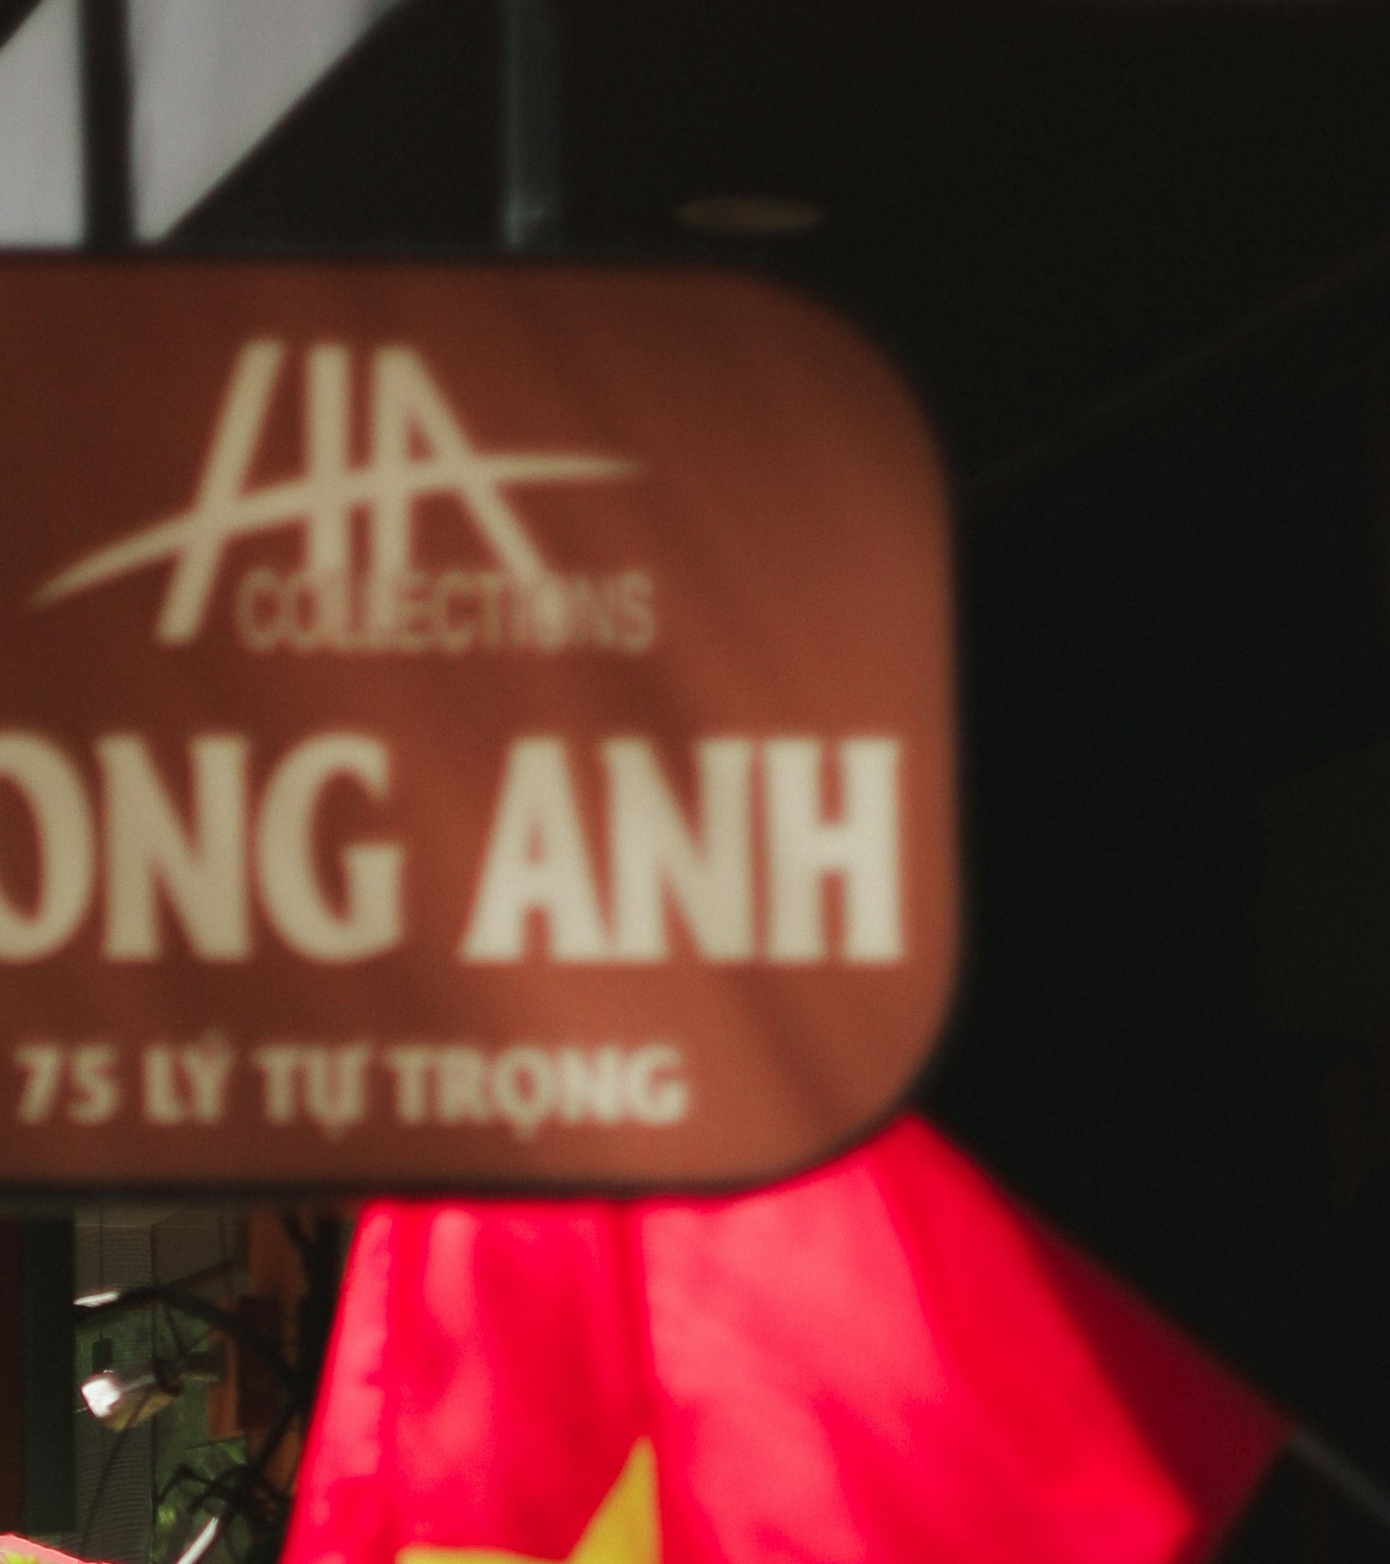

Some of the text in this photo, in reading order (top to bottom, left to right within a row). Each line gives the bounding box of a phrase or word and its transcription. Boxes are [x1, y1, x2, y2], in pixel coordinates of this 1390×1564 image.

[236, 568, 657, 654] COLLECTIONS
[459, 734, 904, 967] ANH
[18, 1042, 118, 1125] 75
[384, 1041, 689, 1137] TRỌNG
